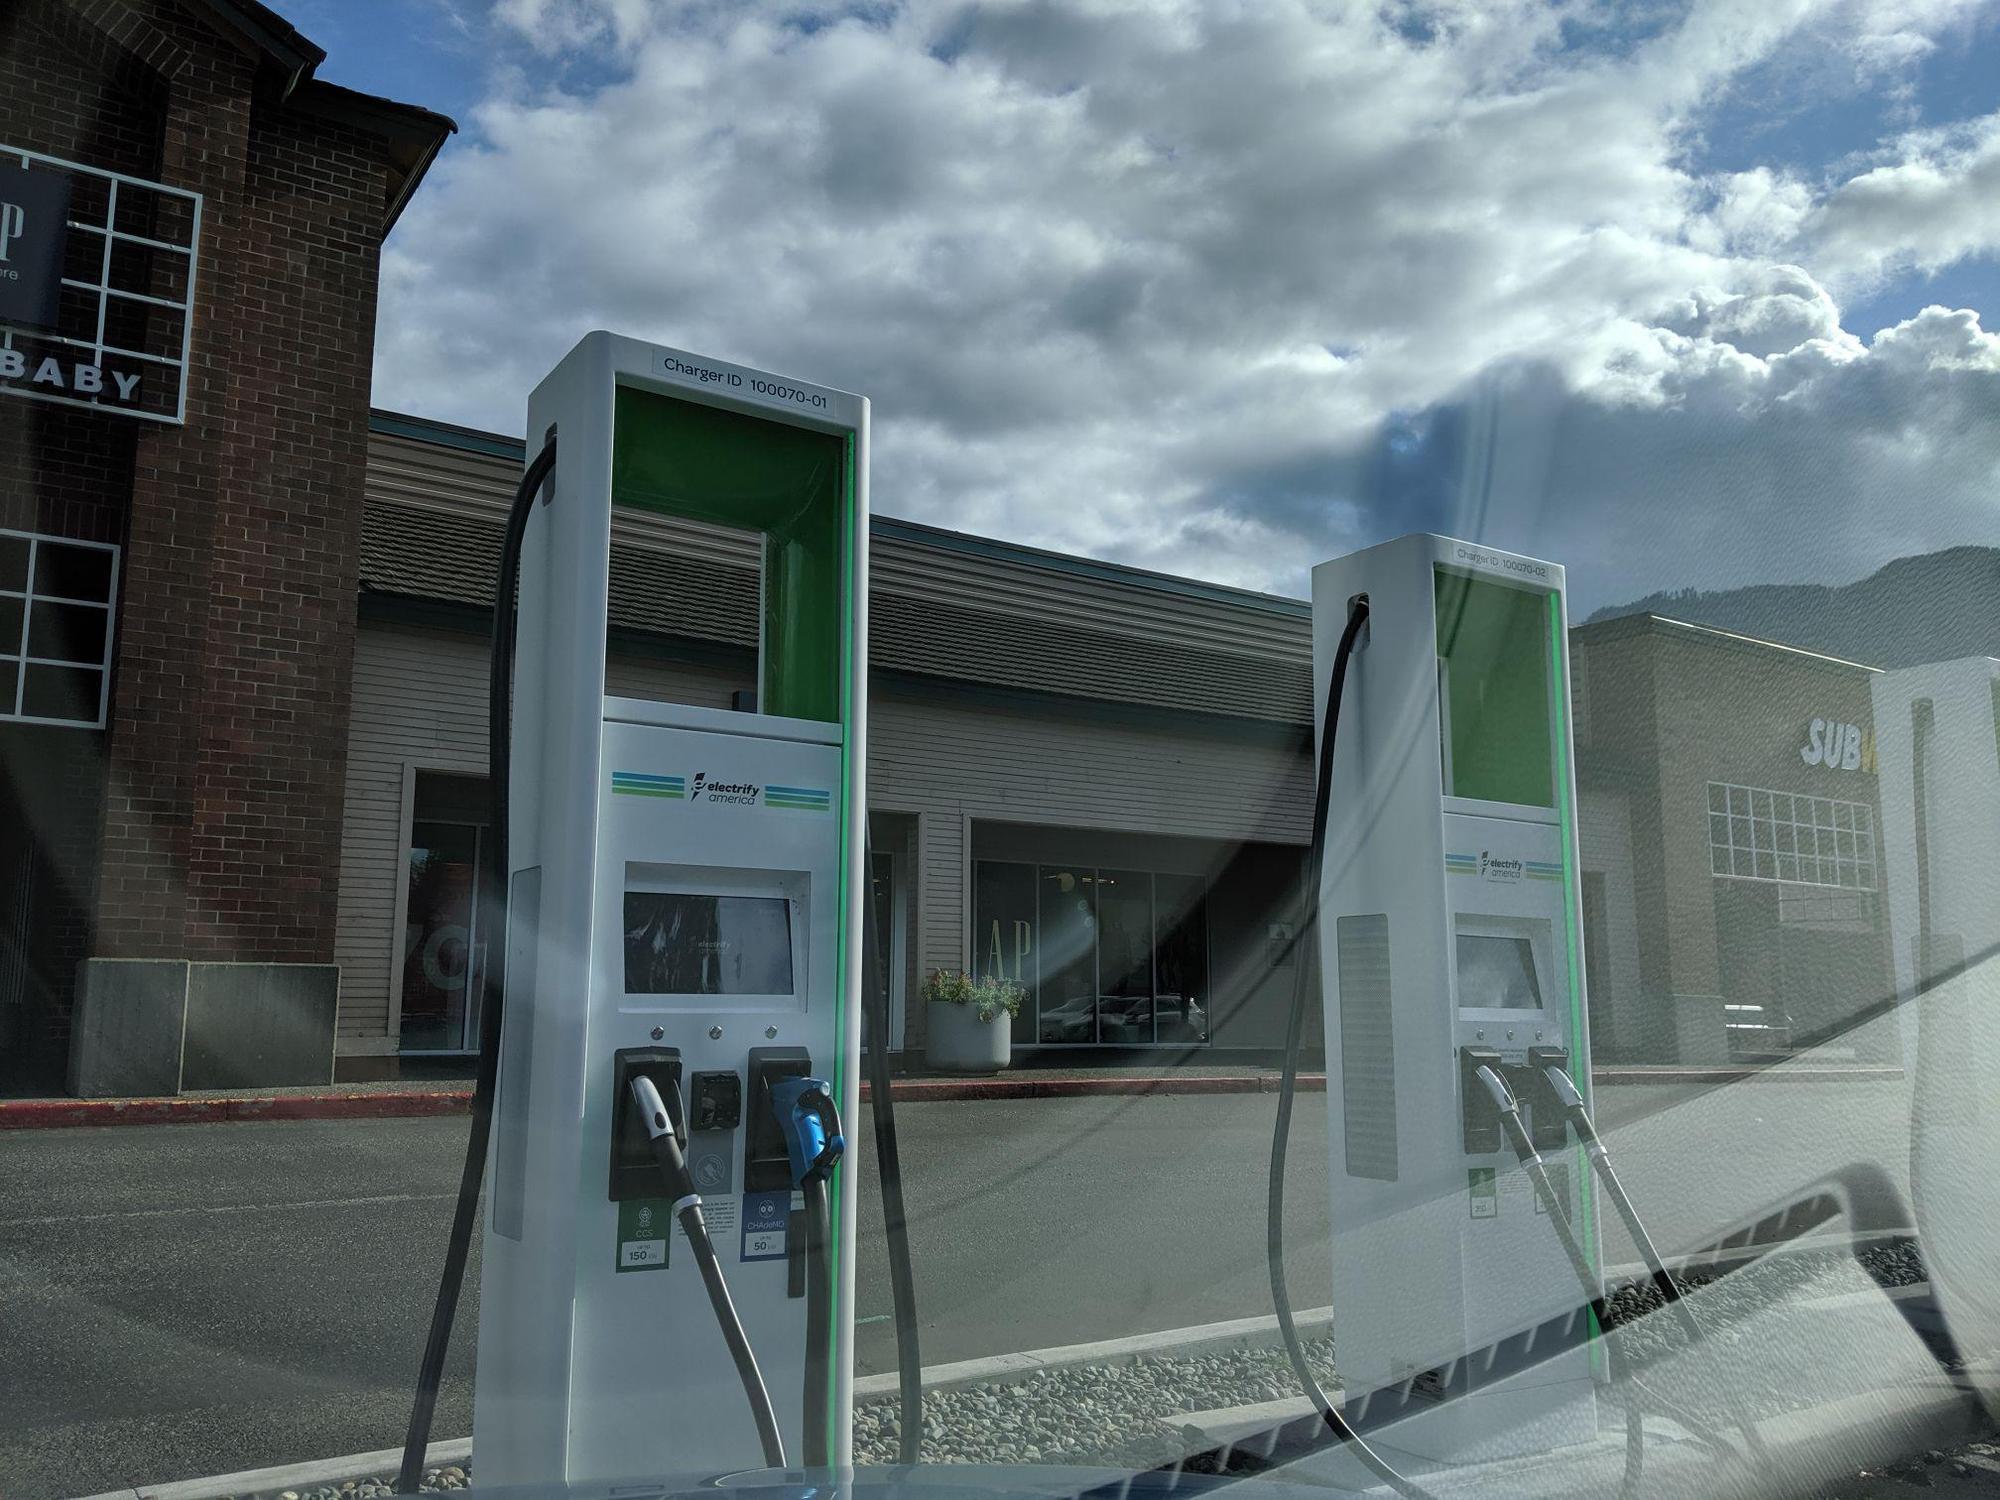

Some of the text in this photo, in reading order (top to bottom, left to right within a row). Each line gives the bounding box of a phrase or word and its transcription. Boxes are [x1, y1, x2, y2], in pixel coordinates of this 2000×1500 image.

[0, 349, 141, 400] BABY
[664, 358, 827, 408] Charger ID 100070-01
[1457, 548, 1546, 578] Charger ID 100070-02
[707, 781, 760, 797] electrify
[708, 793, 756, 805] america
[1490, 859, 1522, 870] electrify
[1492, 869, 1520, 878] america
[753, 1241, 767, 1251] 50
[629, 1250, 647, 1261] 150
